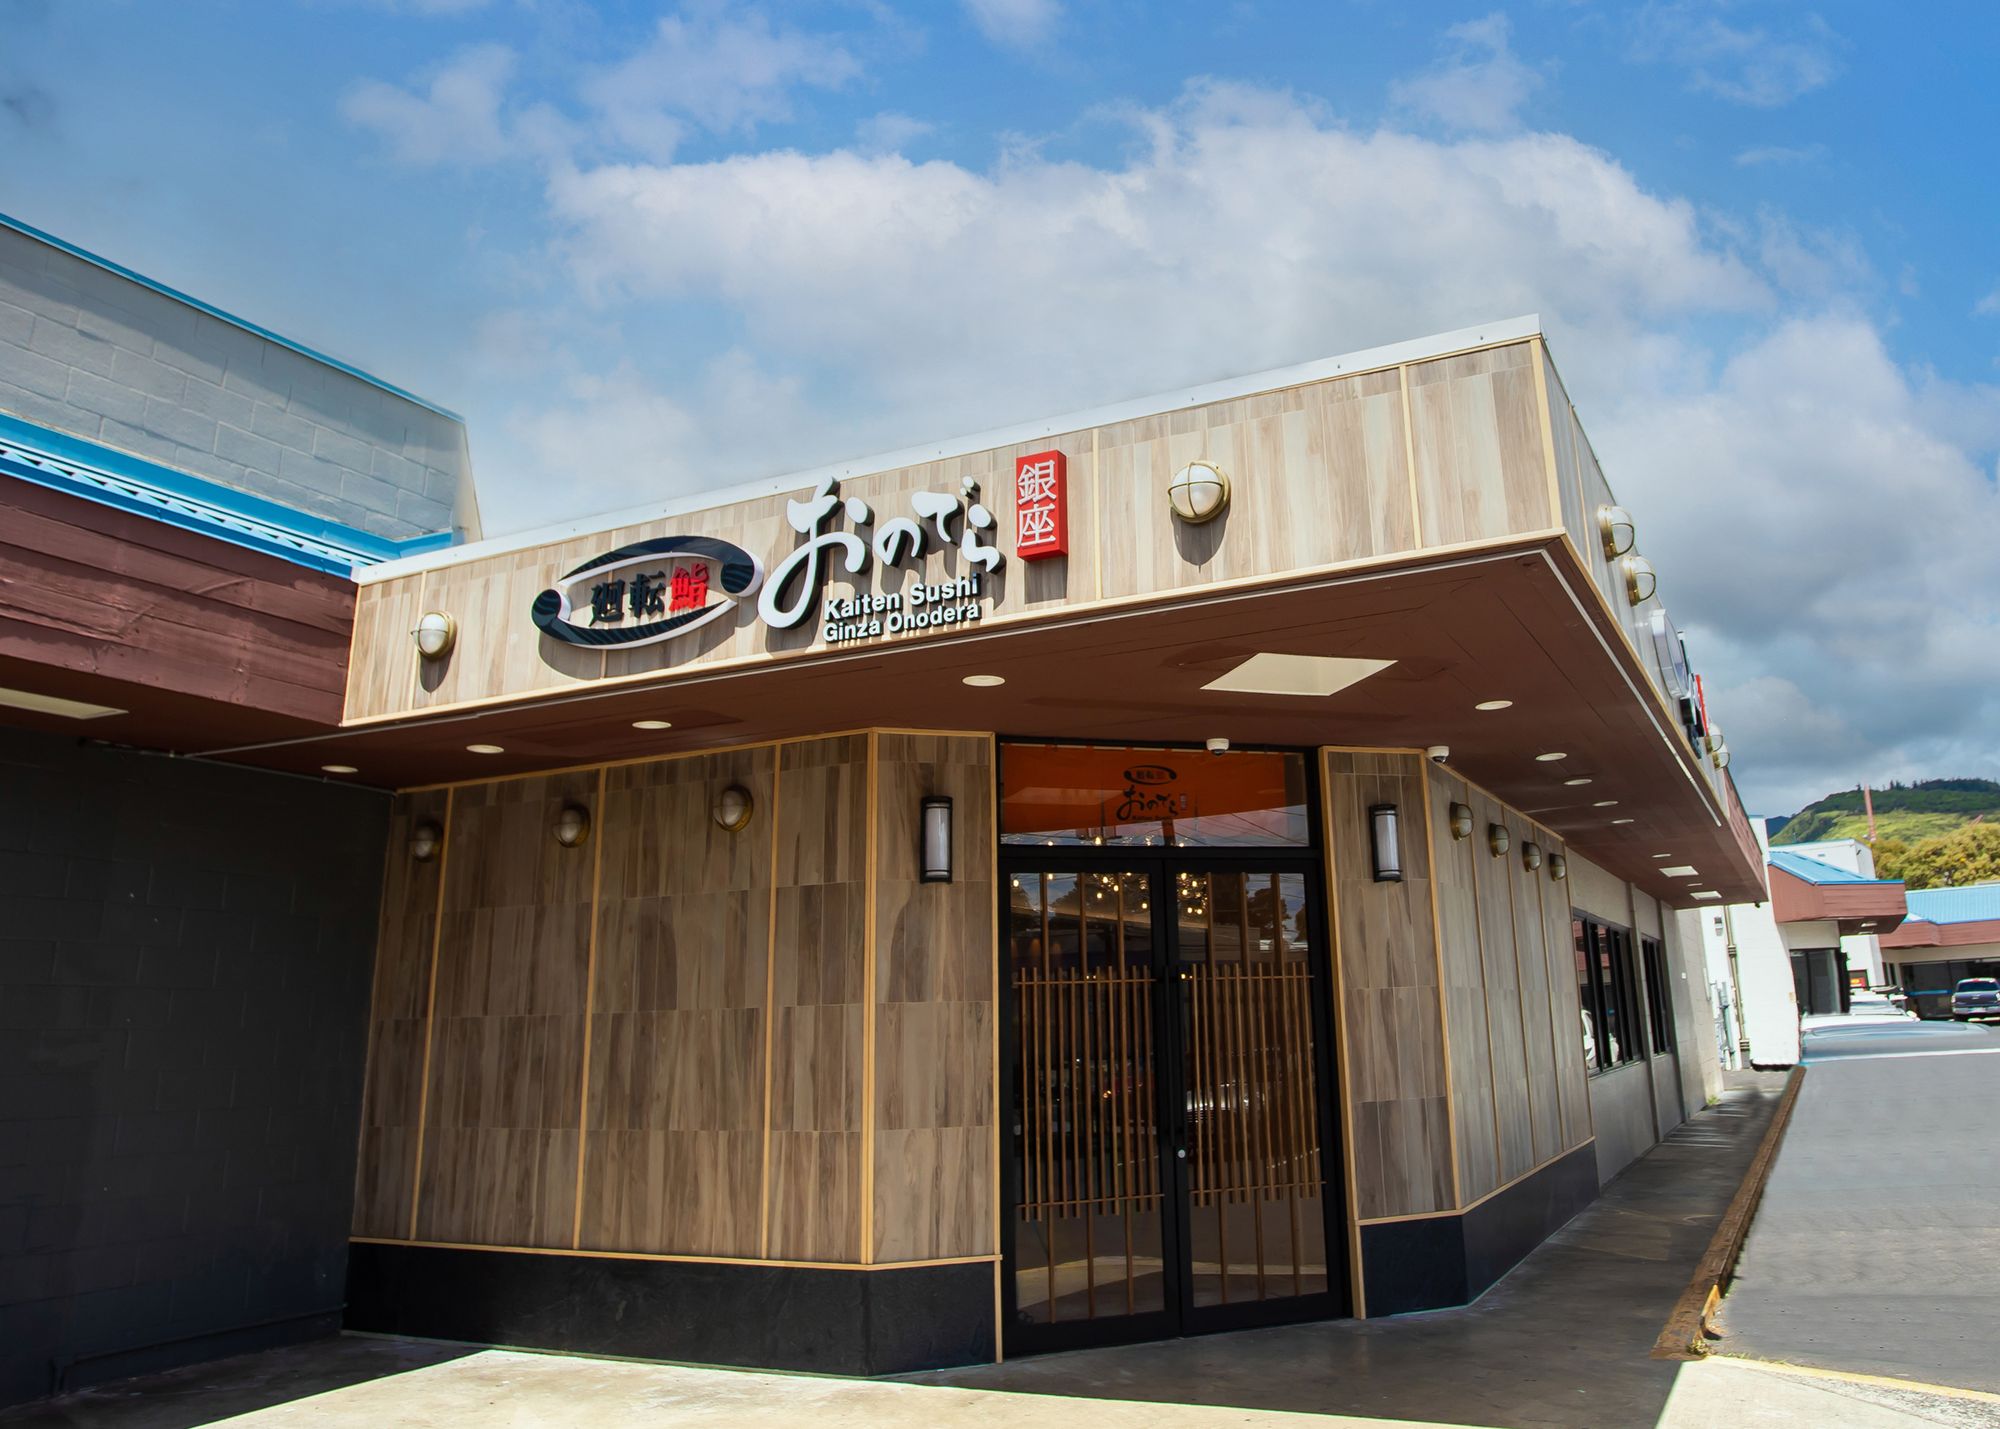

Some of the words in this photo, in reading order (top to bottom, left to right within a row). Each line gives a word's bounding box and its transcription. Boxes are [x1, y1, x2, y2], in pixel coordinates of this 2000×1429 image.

[1018, 459, 1056, 547] 銀座
[757, 476, 1001, 629] おのでら
[822, 620, 882, 642] Ginza
[887, 603, 980, 633] Onodera
[823, 592, 902, 621] Kaiten
[909, 572, 980, 606] Sushi
